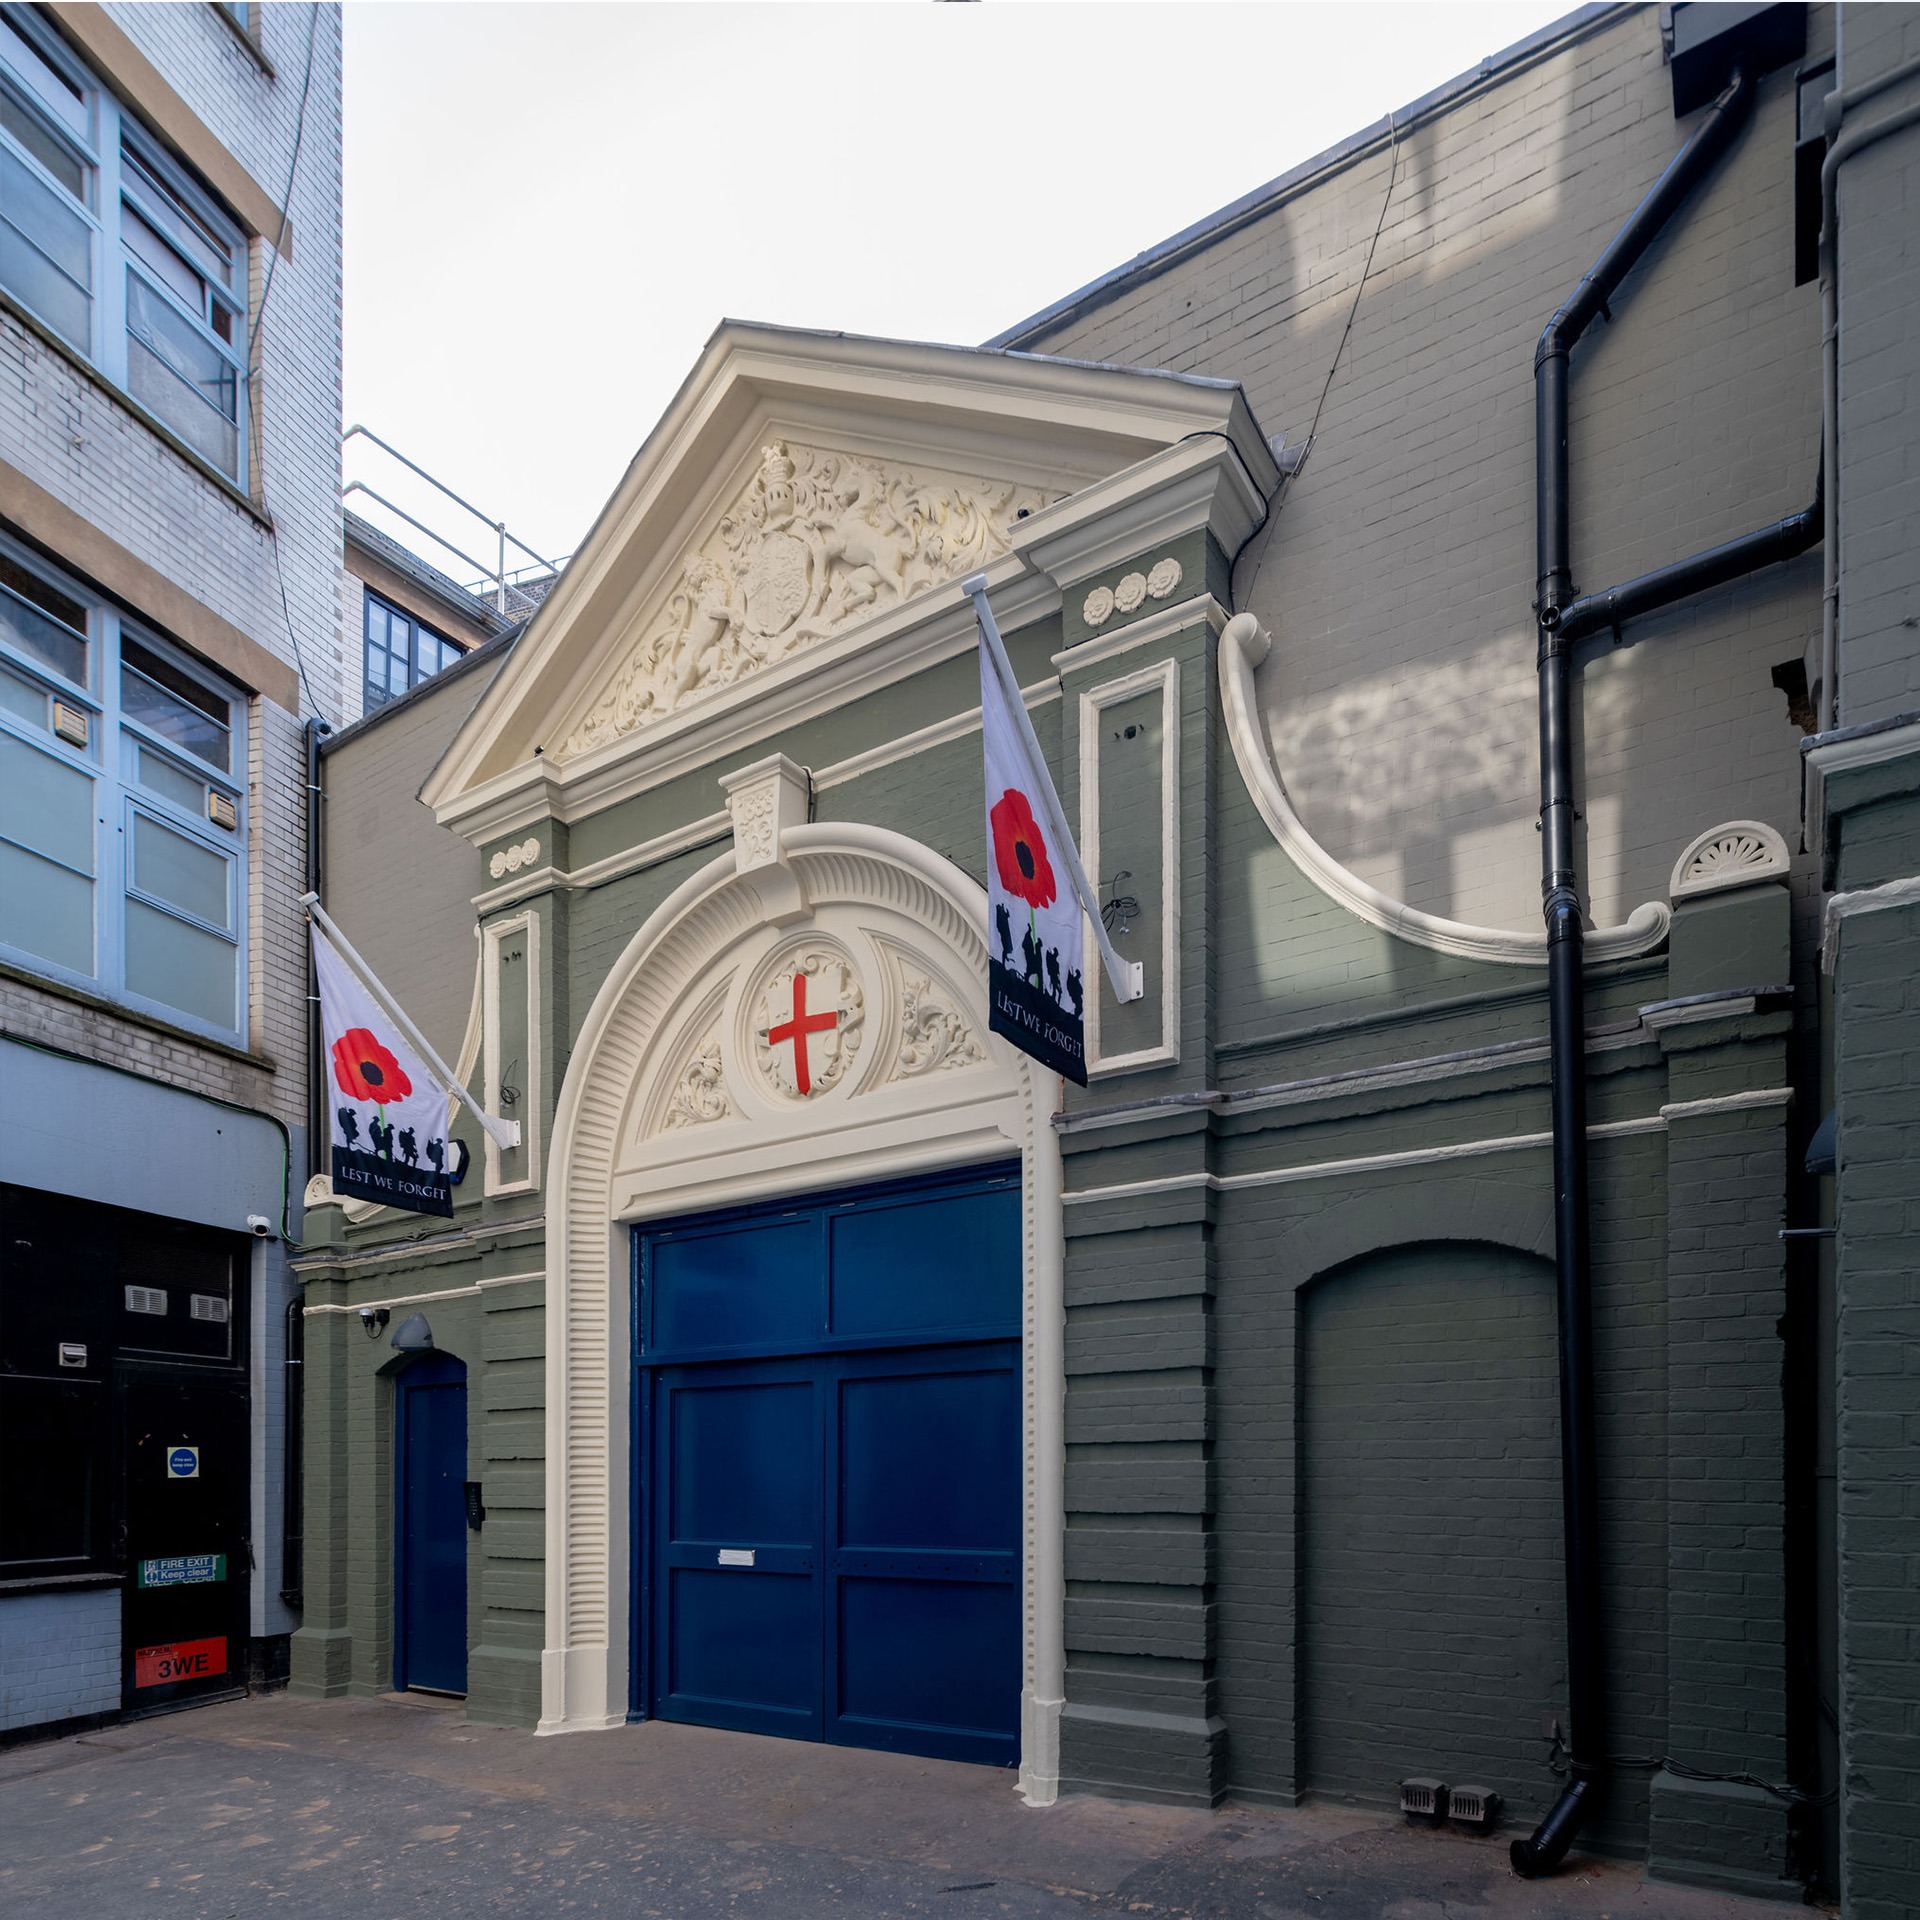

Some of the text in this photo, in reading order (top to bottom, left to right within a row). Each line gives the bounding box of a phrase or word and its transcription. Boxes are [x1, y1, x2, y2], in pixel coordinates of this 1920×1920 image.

[997, 990, 1082, 1058] LEST WE FORGET
[342, 1166, 447, 1200] LEST WE FORGET
[161, 1557, 210, 1569] FIRE EXIT
[161, 1568, 210, 1580] Keep clear
[158, 1653, 209, 1679] 3WE
